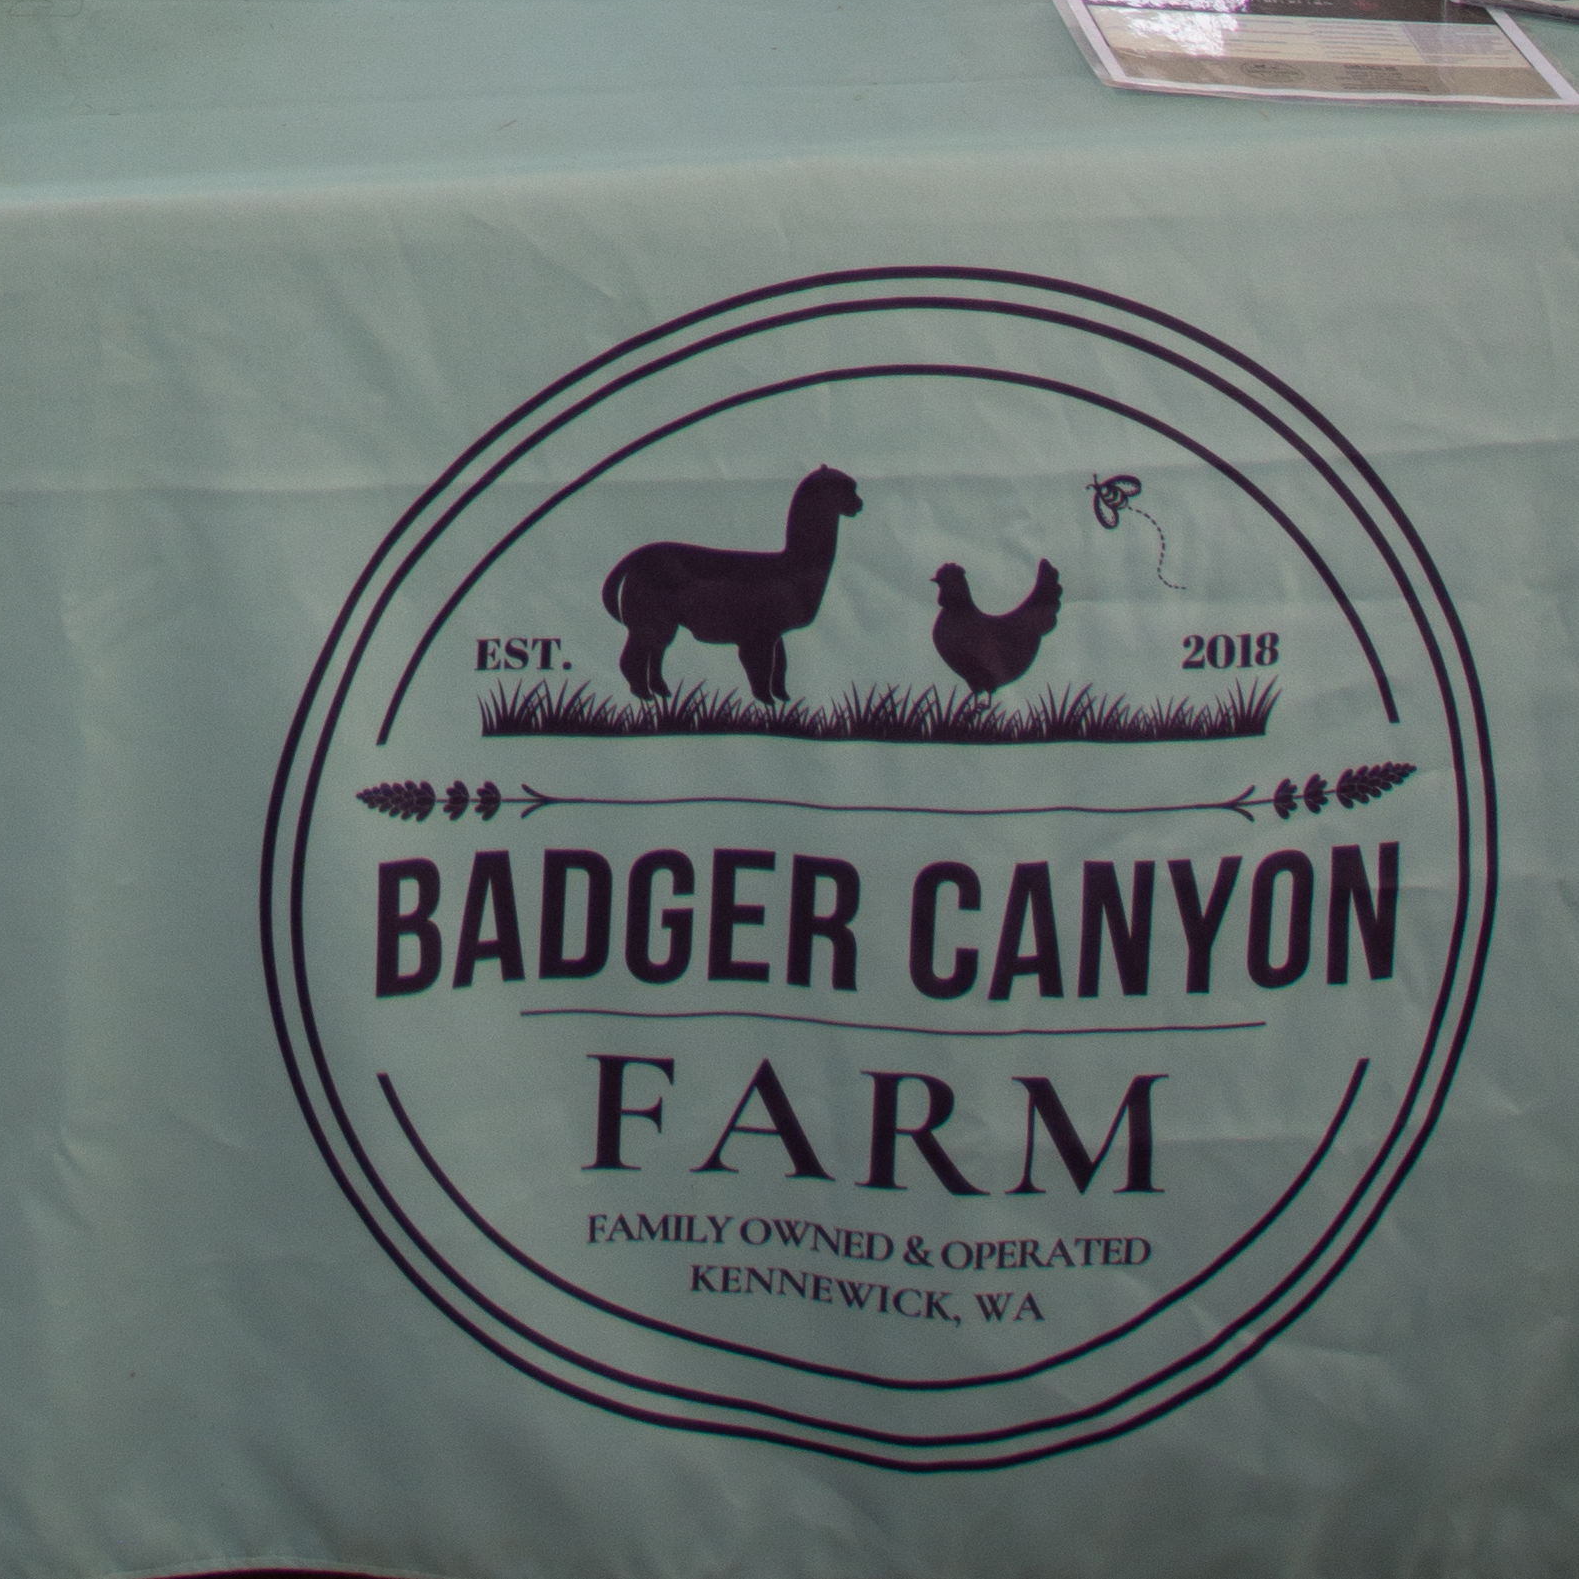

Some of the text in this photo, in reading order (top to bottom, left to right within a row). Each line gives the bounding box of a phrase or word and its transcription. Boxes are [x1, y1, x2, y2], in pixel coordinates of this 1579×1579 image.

[474, 637, 573, 672] EST.
[1181, 631, 1280, 671] 2018
[375, 840, 1400, 1003] BADGER CANYON
[580, 1053, 1170, 1198] FARM
[588, 1214, 1153, 1272] FAMILY OWNED & OPERATED
[690, 1263, 1047, 1328] KENNEWICK, WA
